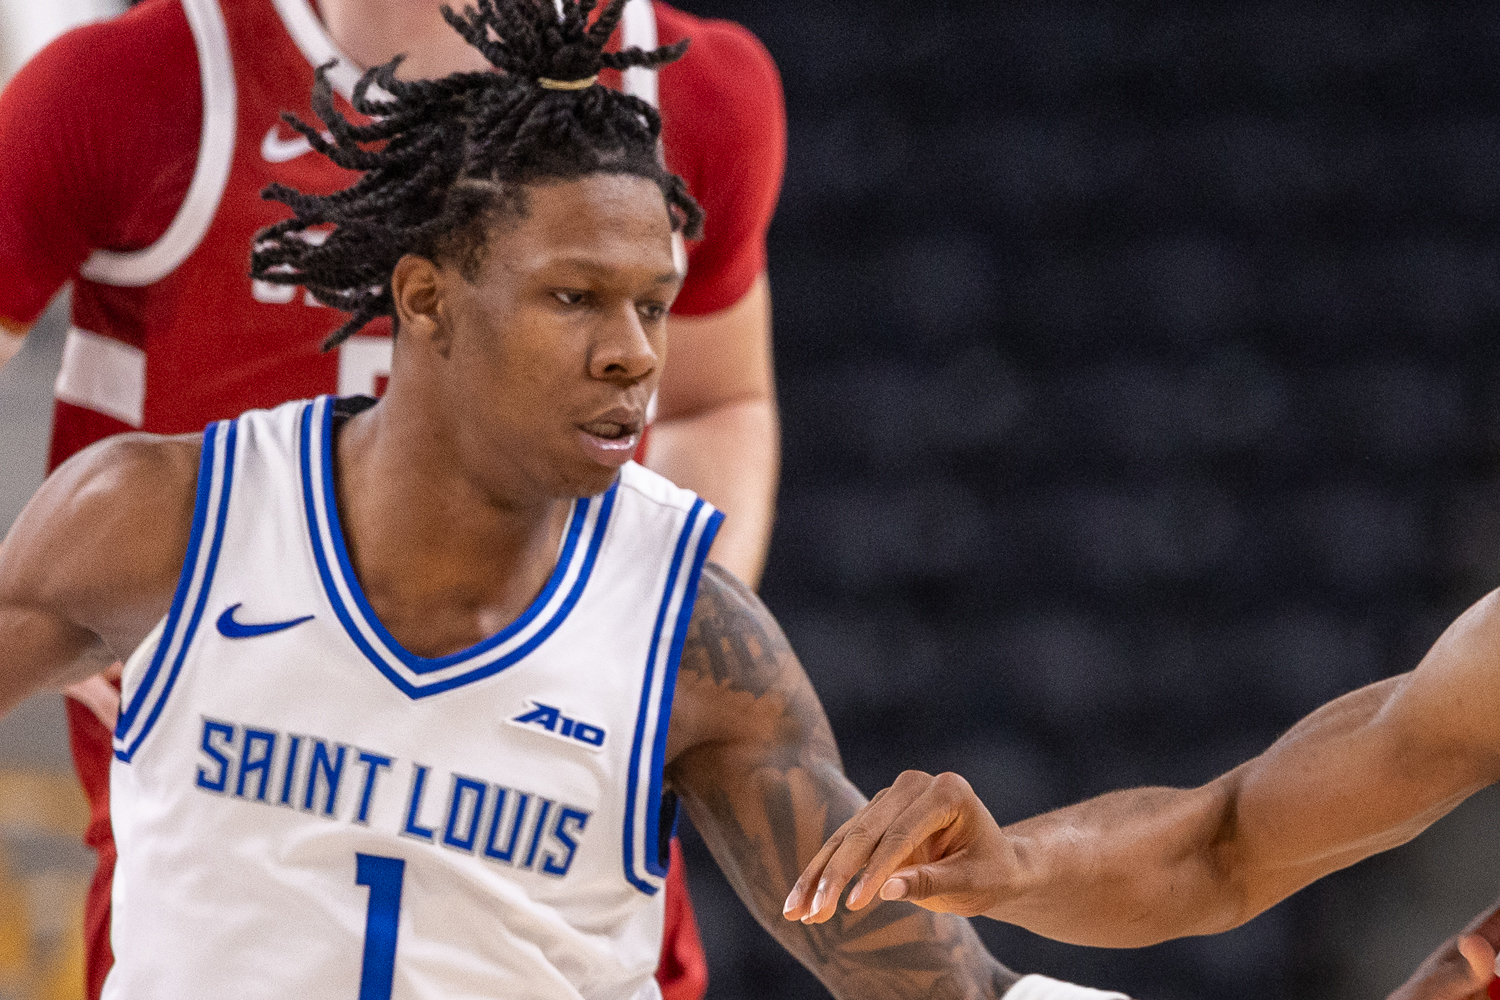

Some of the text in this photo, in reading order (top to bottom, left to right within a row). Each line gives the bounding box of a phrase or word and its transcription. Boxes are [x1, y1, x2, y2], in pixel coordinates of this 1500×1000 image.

[512, 701, 606, 747] A10
[195, 717, 593, 877] SAINT LOUIS
